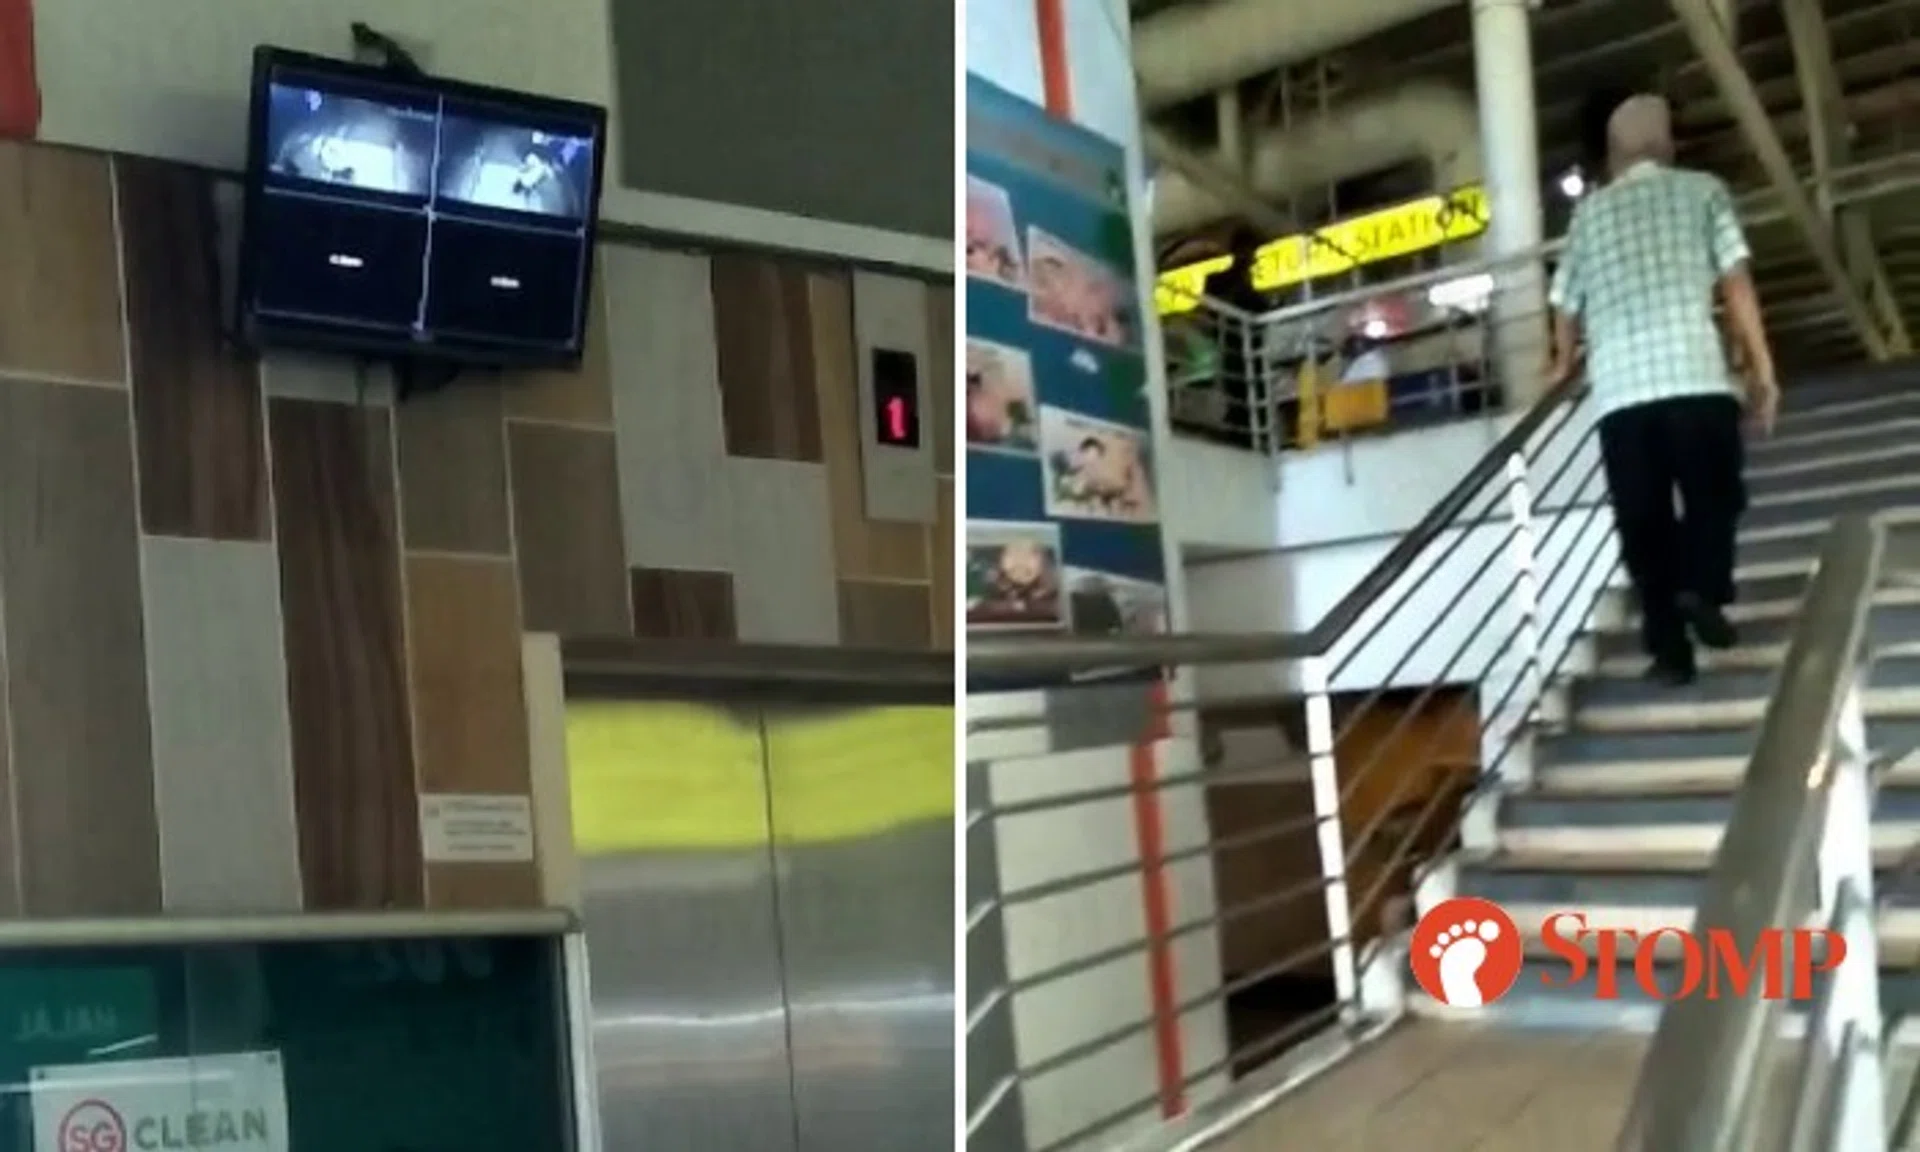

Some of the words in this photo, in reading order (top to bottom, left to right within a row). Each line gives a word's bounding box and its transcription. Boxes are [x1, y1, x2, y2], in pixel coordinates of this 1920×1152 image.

[1355, 192, 1482, 250] STATION
[886, 397, 906, 439] 1
[68, 1122, 118, 1152] SG
[135, 1110, 268, 1149] CLEAN
